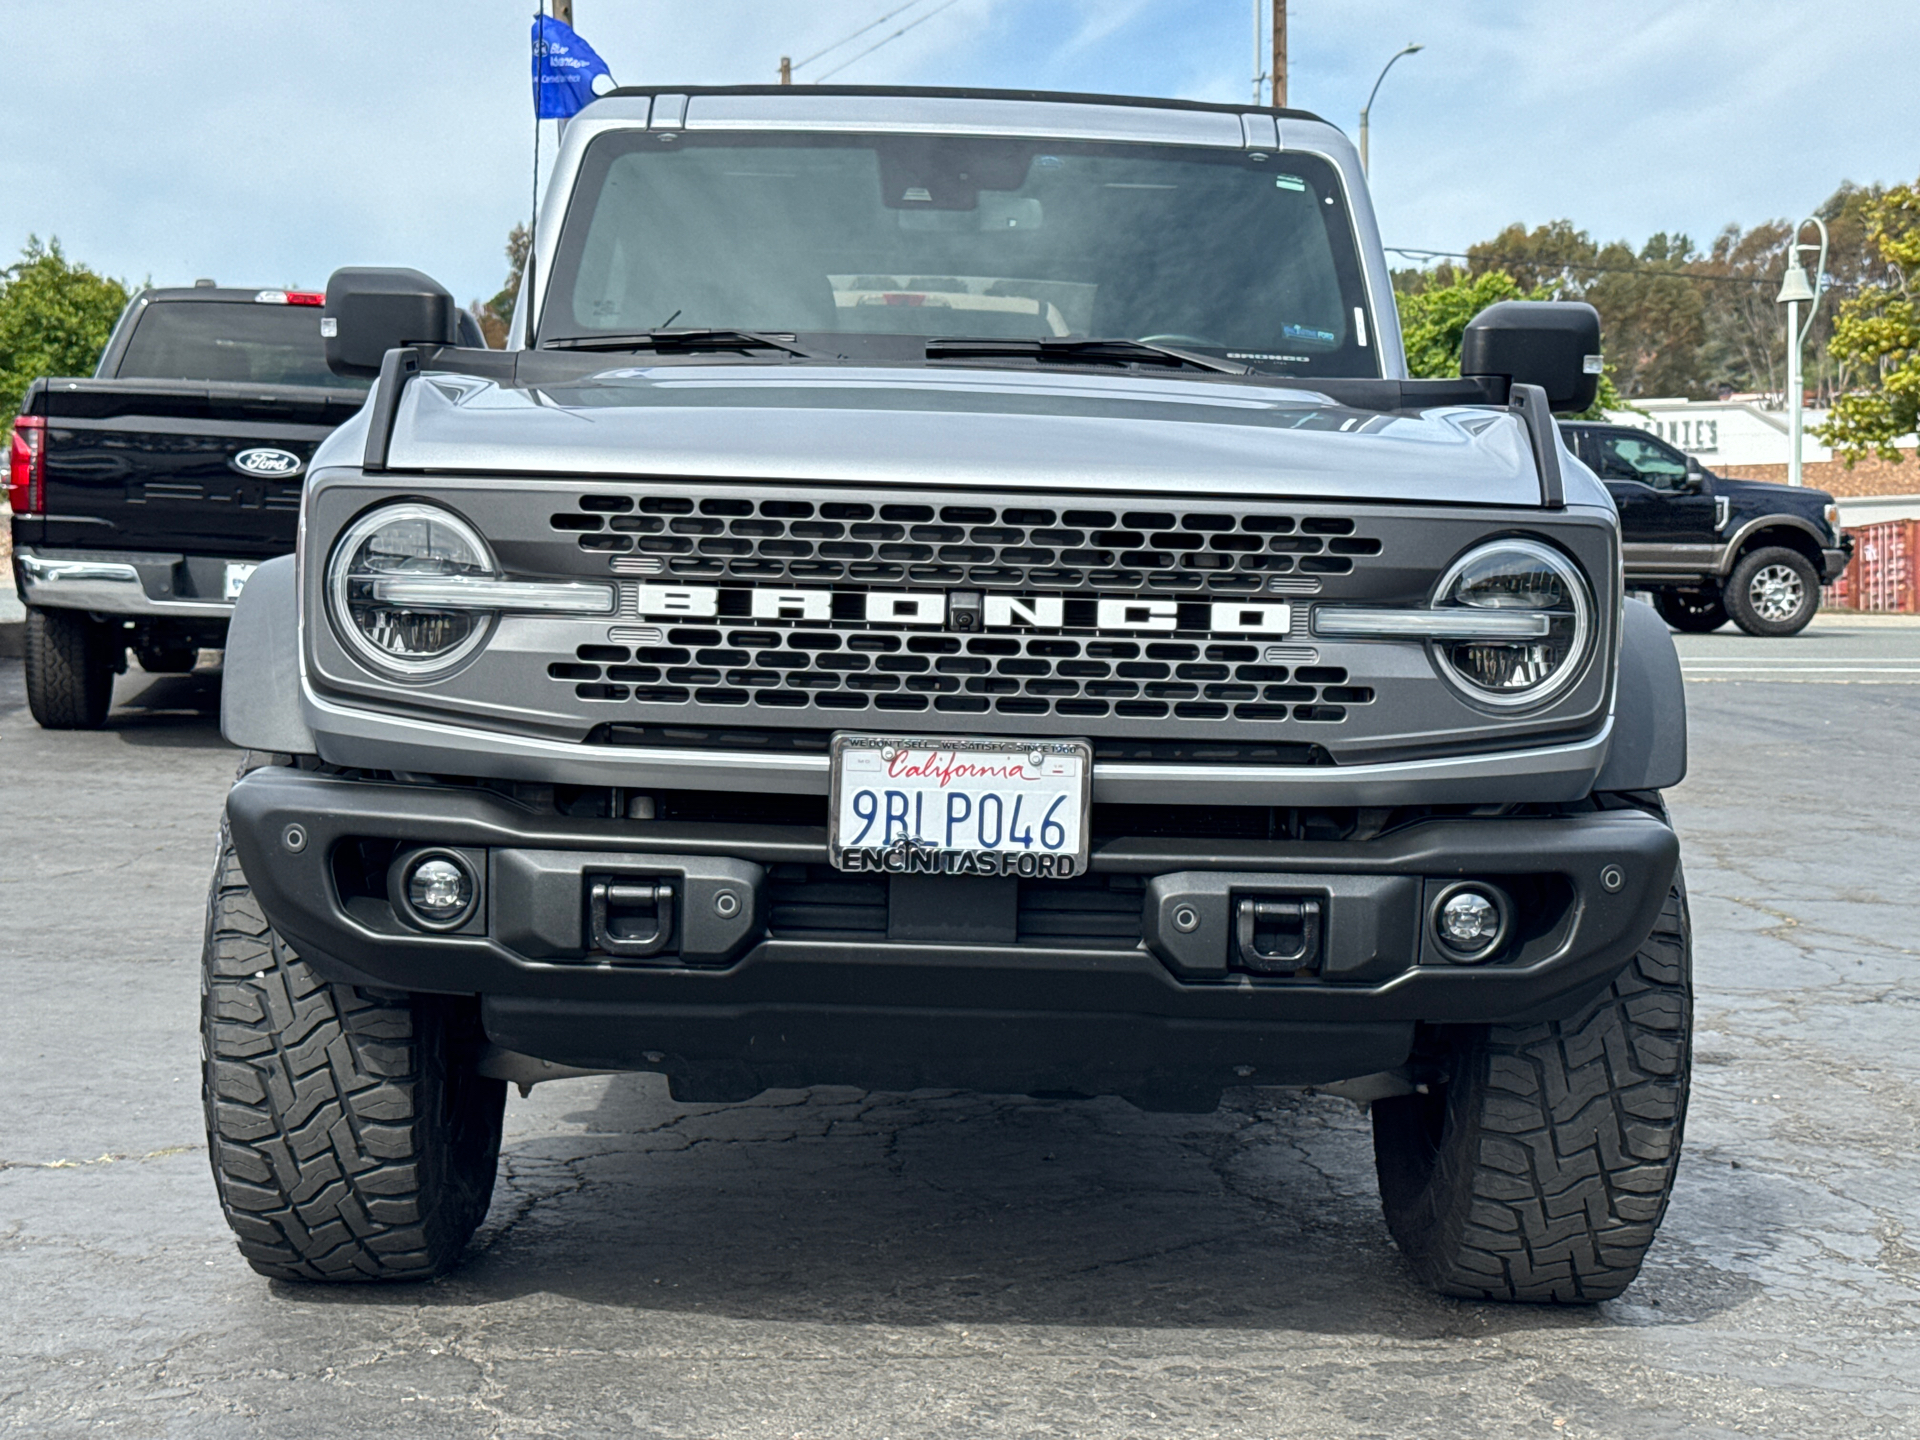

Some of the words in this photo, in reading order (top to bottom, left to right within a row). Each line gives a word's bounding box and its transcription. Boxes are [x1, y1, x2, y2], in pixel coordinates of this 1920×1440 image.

[246, 452, 290, 471] Ford
[637, 584, 1291, 634] BRONCO
[850, 738, 867, 747] WE
[869, 738, 902, 748] DON'T
[941, 740, 958, 750] WE
[960, 741, 1005, 752] SATISFY
[1016, 742, 1049, 753] SINCE
[888, 750, 1041, 788] California
[842, 848, 997, 875] ENCINITAS
[1001, 851, 1076, 878] FORD
